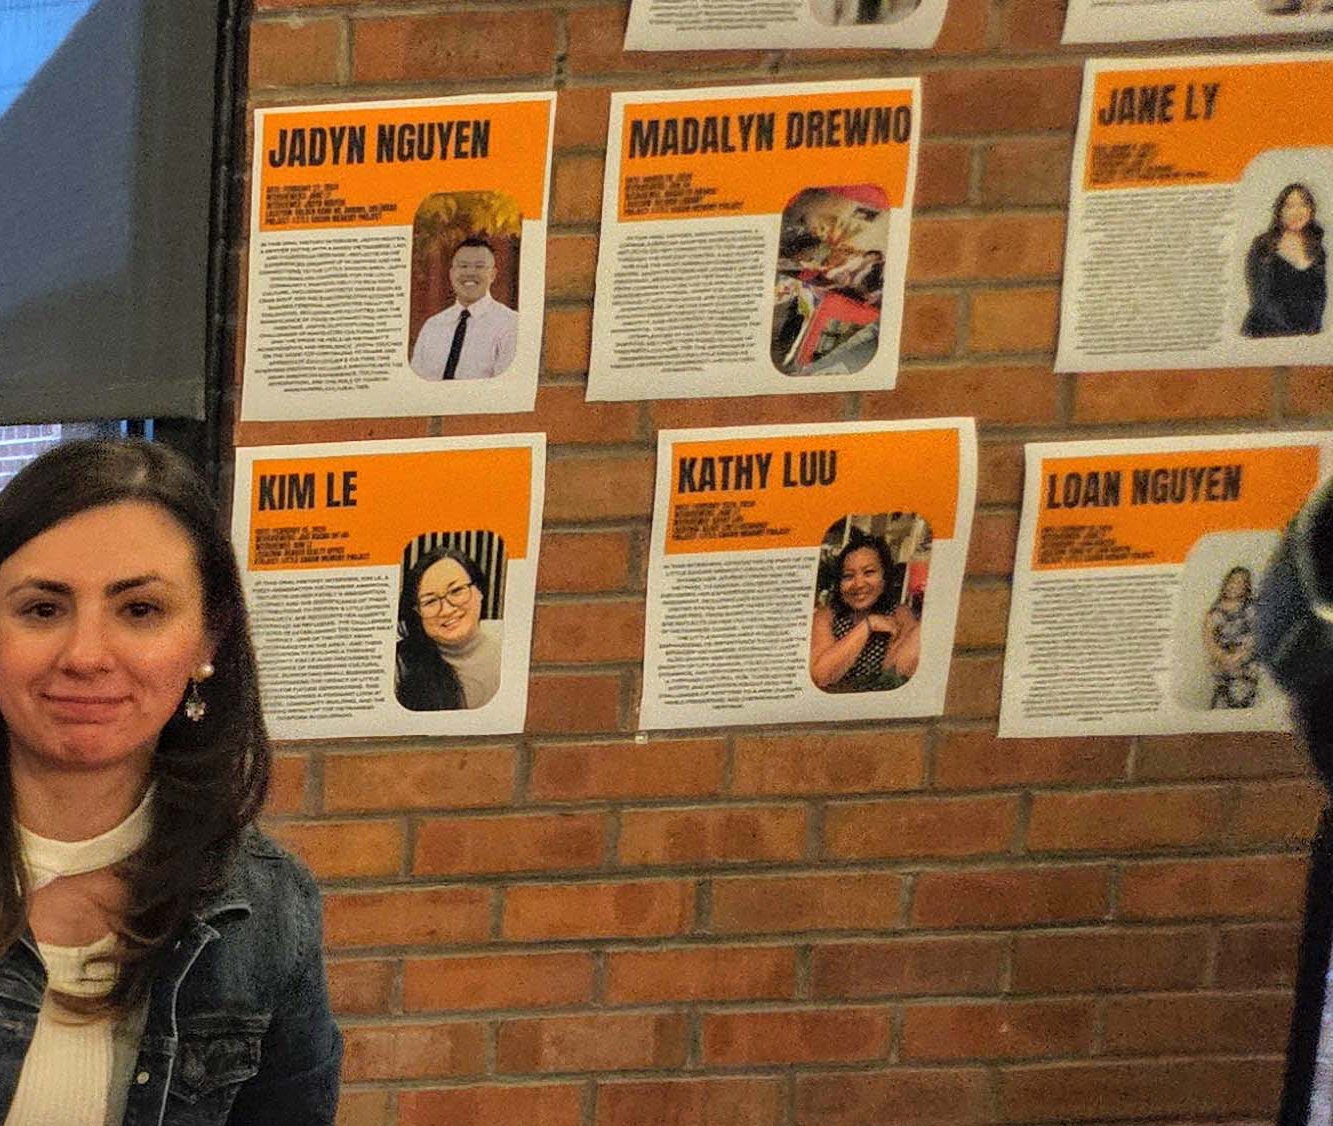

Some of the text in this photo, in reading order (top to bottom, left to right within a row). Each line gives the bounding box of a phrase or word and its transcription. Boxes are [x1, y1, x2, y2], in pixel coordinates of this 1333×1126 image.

[1099, 83, 1221, 127] JANE LY
[268, 120, 490, 168] JADYN NGUYEN
[629, 105, 911, 158] MADALYN DREWNO
[258, 470, 358, 511] KIM LE
[678, 450, 838, 493] KATHY LUU
[1046, 465, 1244, 509] LOAN NGUYEN
